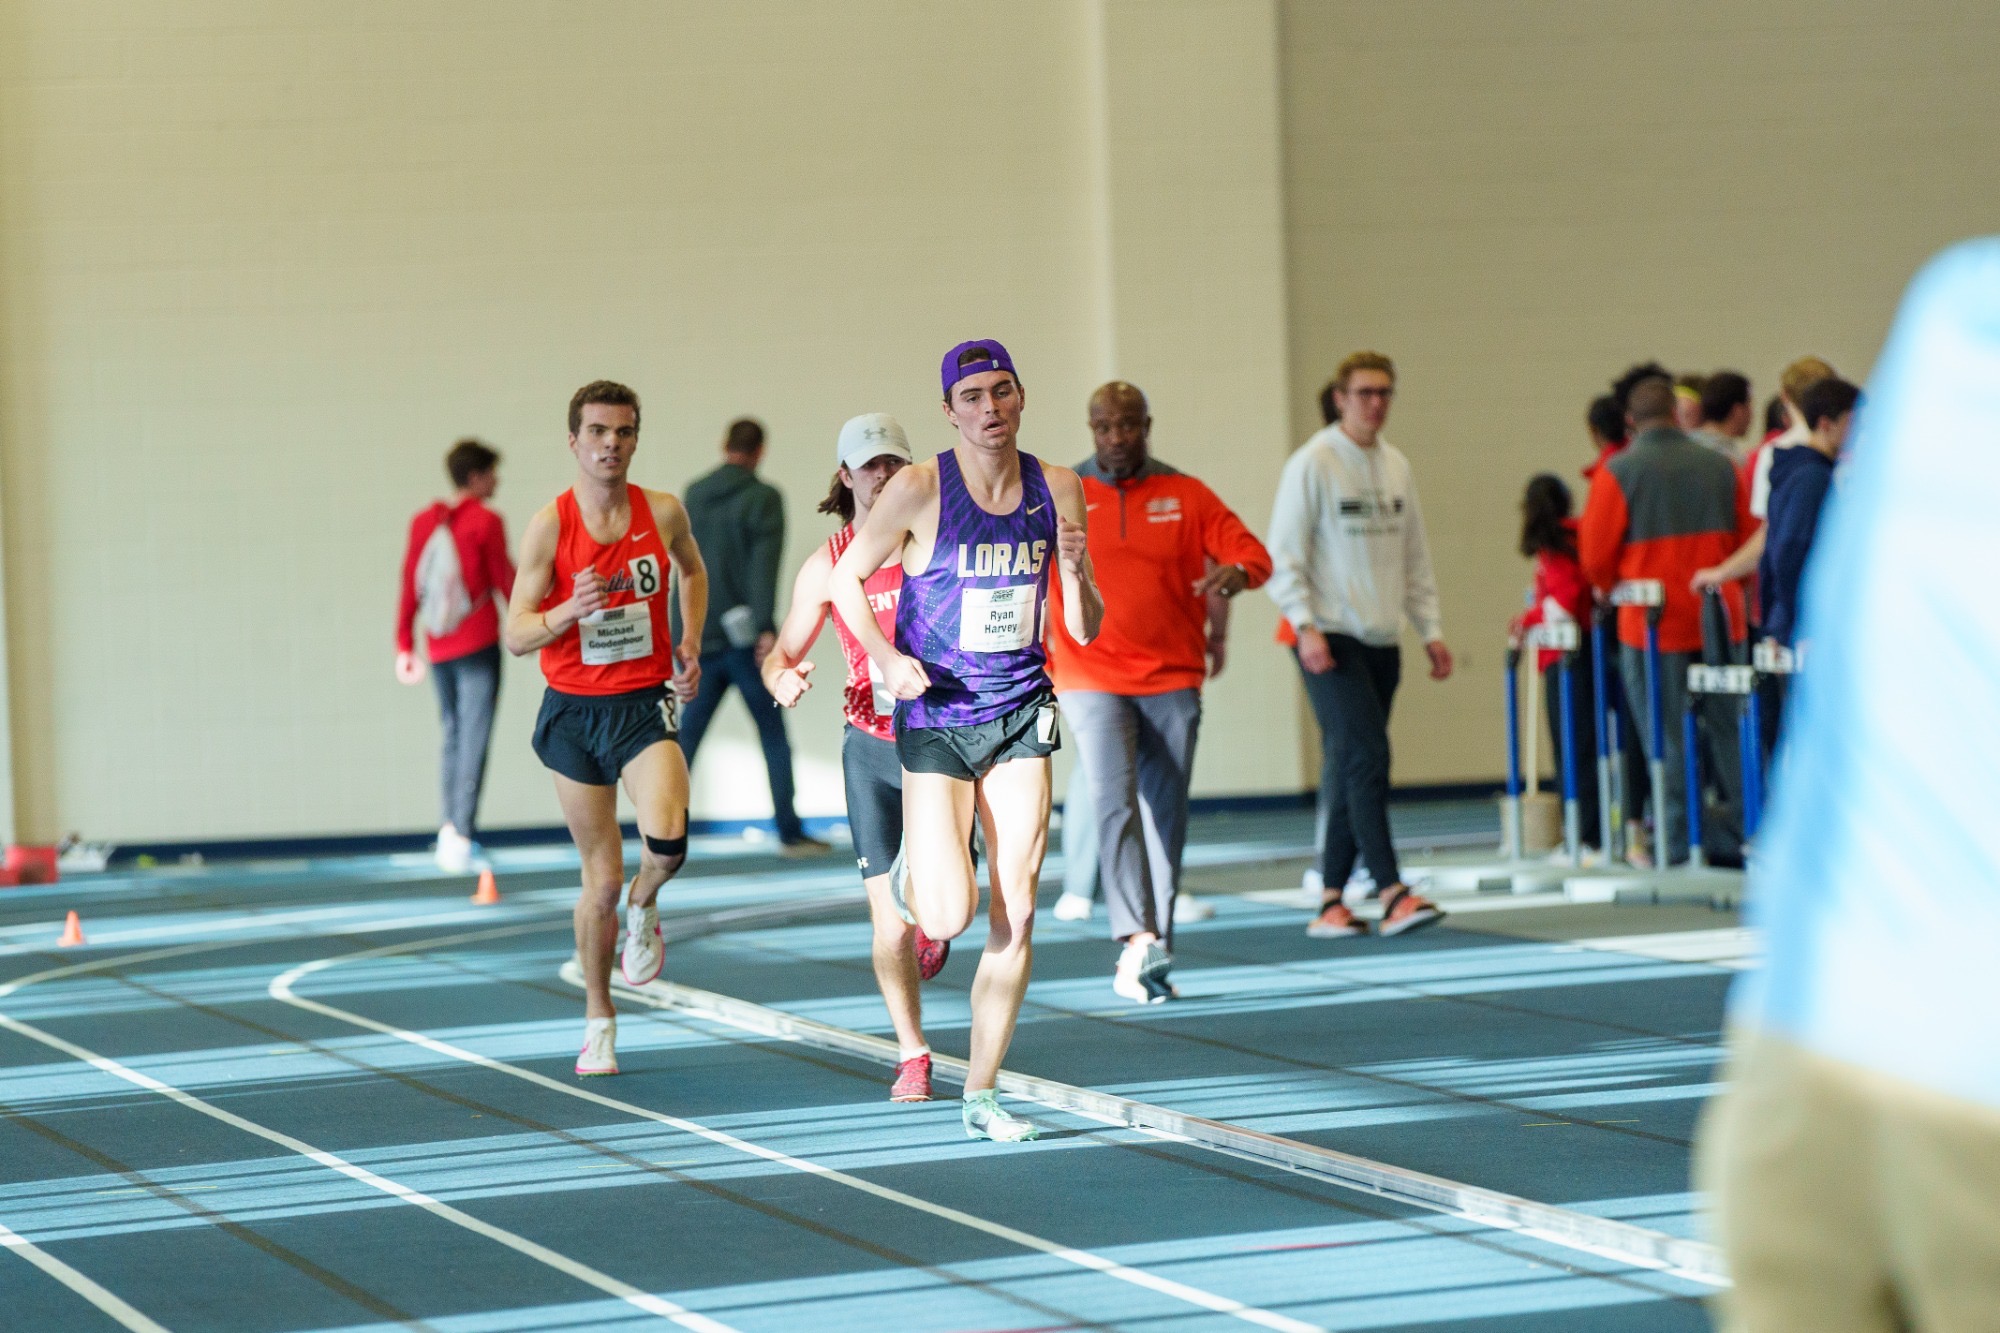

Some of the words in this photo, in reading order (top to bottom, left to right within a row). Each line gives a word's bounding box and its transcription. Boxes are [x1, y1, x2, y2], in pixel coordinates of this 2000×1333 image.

[957, 540, 1047, 578] LORAS
[637, 559, 655, 593] 8
[990, 610, 1014, 622] Ryan
[597, 624, 635, 637] Michael
[984, 623, 1018, 634] Harvey
[588, 635, 644, 649] Goodenbour
